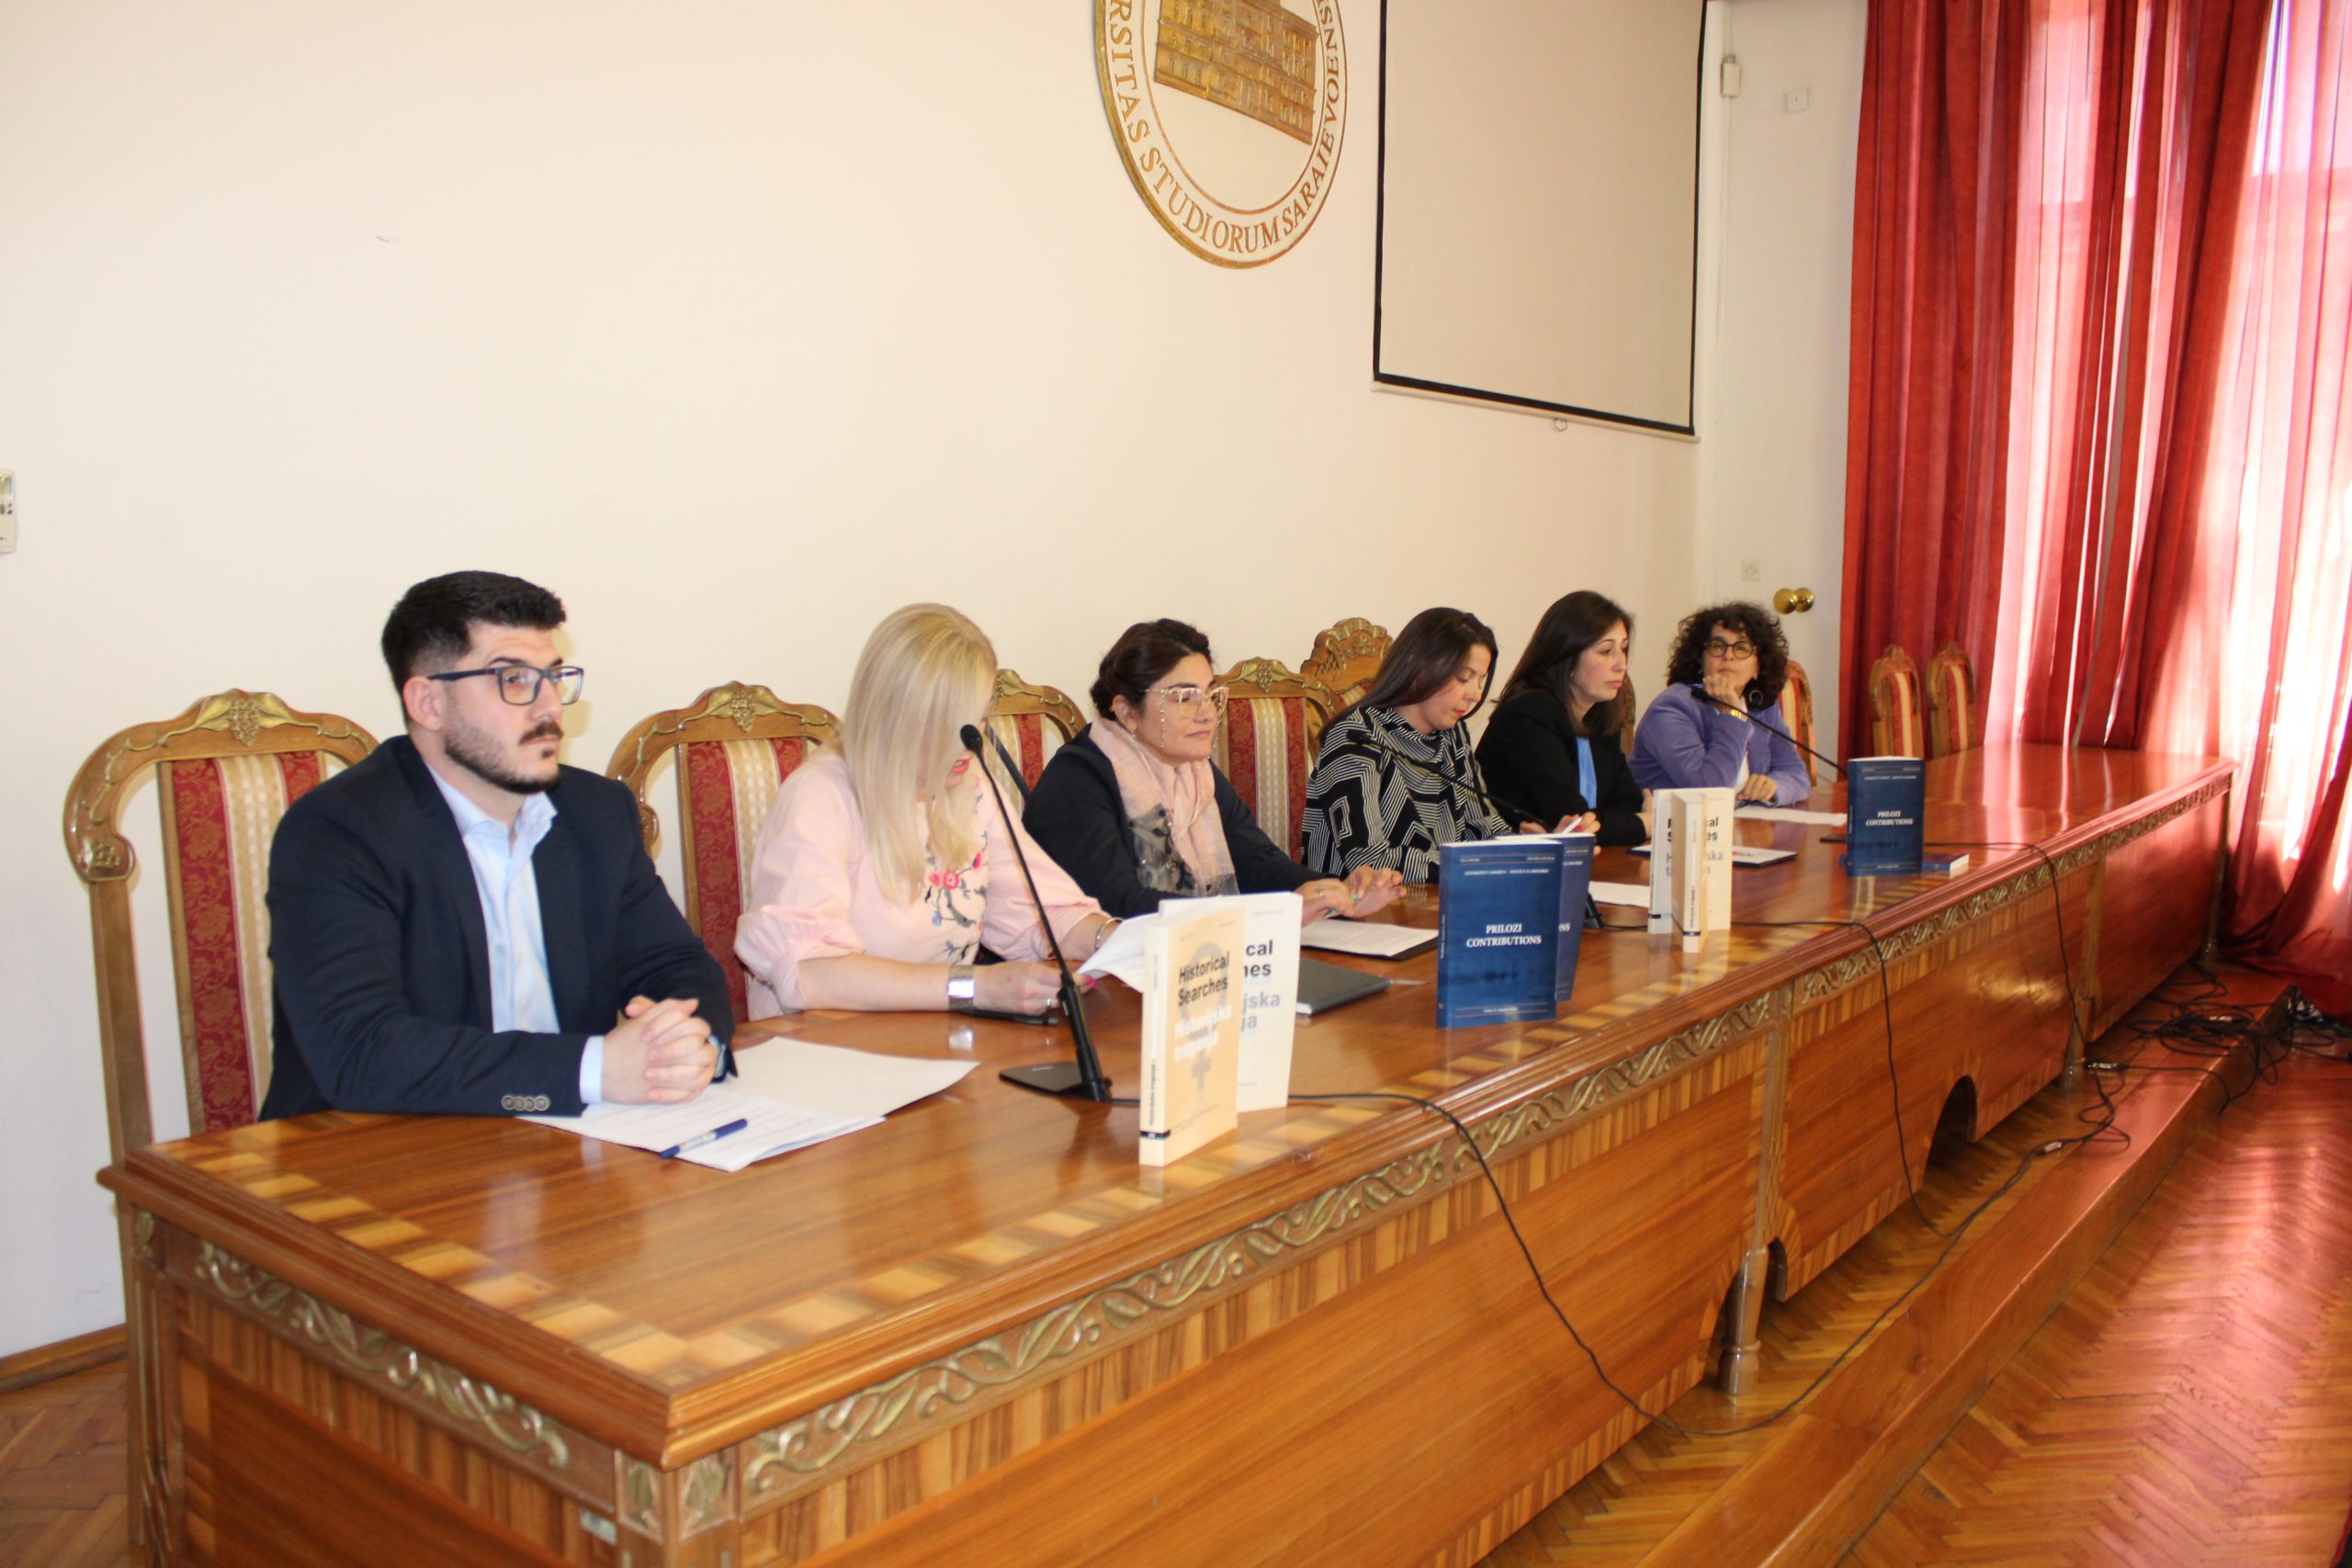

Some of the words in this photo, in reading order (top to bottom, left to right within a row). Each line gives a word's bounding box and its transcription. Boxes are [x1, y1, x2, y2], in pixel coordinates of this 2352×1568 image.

[1139, 147, 1283, 254] STUDIORUM
[1466, 935, 1543, 948] CONTRIBUTIONS
[1486, 923, 1522, 934] PRILOZI
[1179, 951, 1230, 985] Historical
[1178, 976, 1228, 1007] Searches
